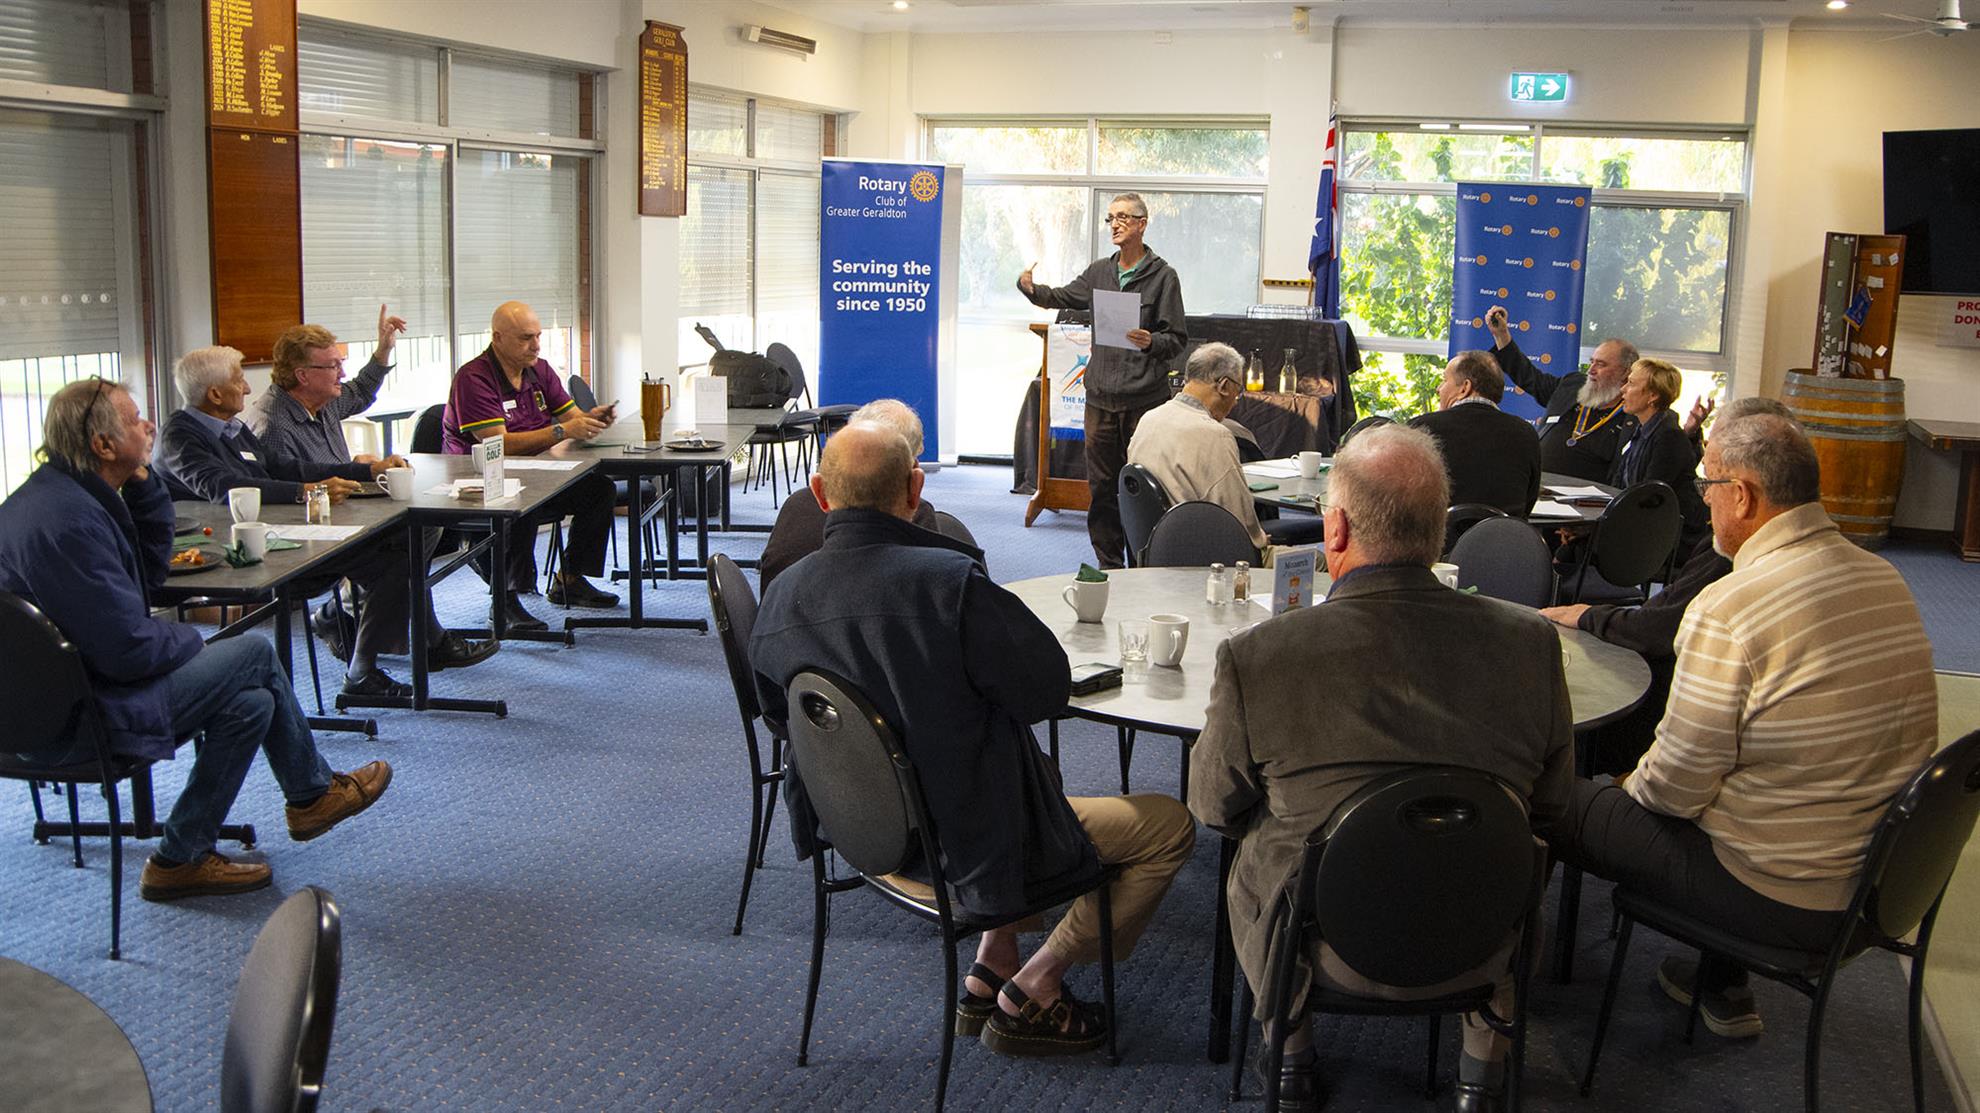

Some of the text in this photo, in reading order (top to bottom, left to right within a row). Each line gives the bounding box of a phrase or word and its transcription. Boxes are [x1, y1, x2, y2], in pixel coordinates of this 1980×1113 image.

[859, 176, 906, 194] Rotary
[875, 195, 908, 207] Club of
[826, 206, 907, 219] Greater Geraldton
[832, 260, 932, 278] Serving the
[832, 279, 931, 297] community
[1479, 288, 1497, 296] Rotary
[1526, 291, 1544, 299] Rotary
[836, 297, 926, 312] since 1950
